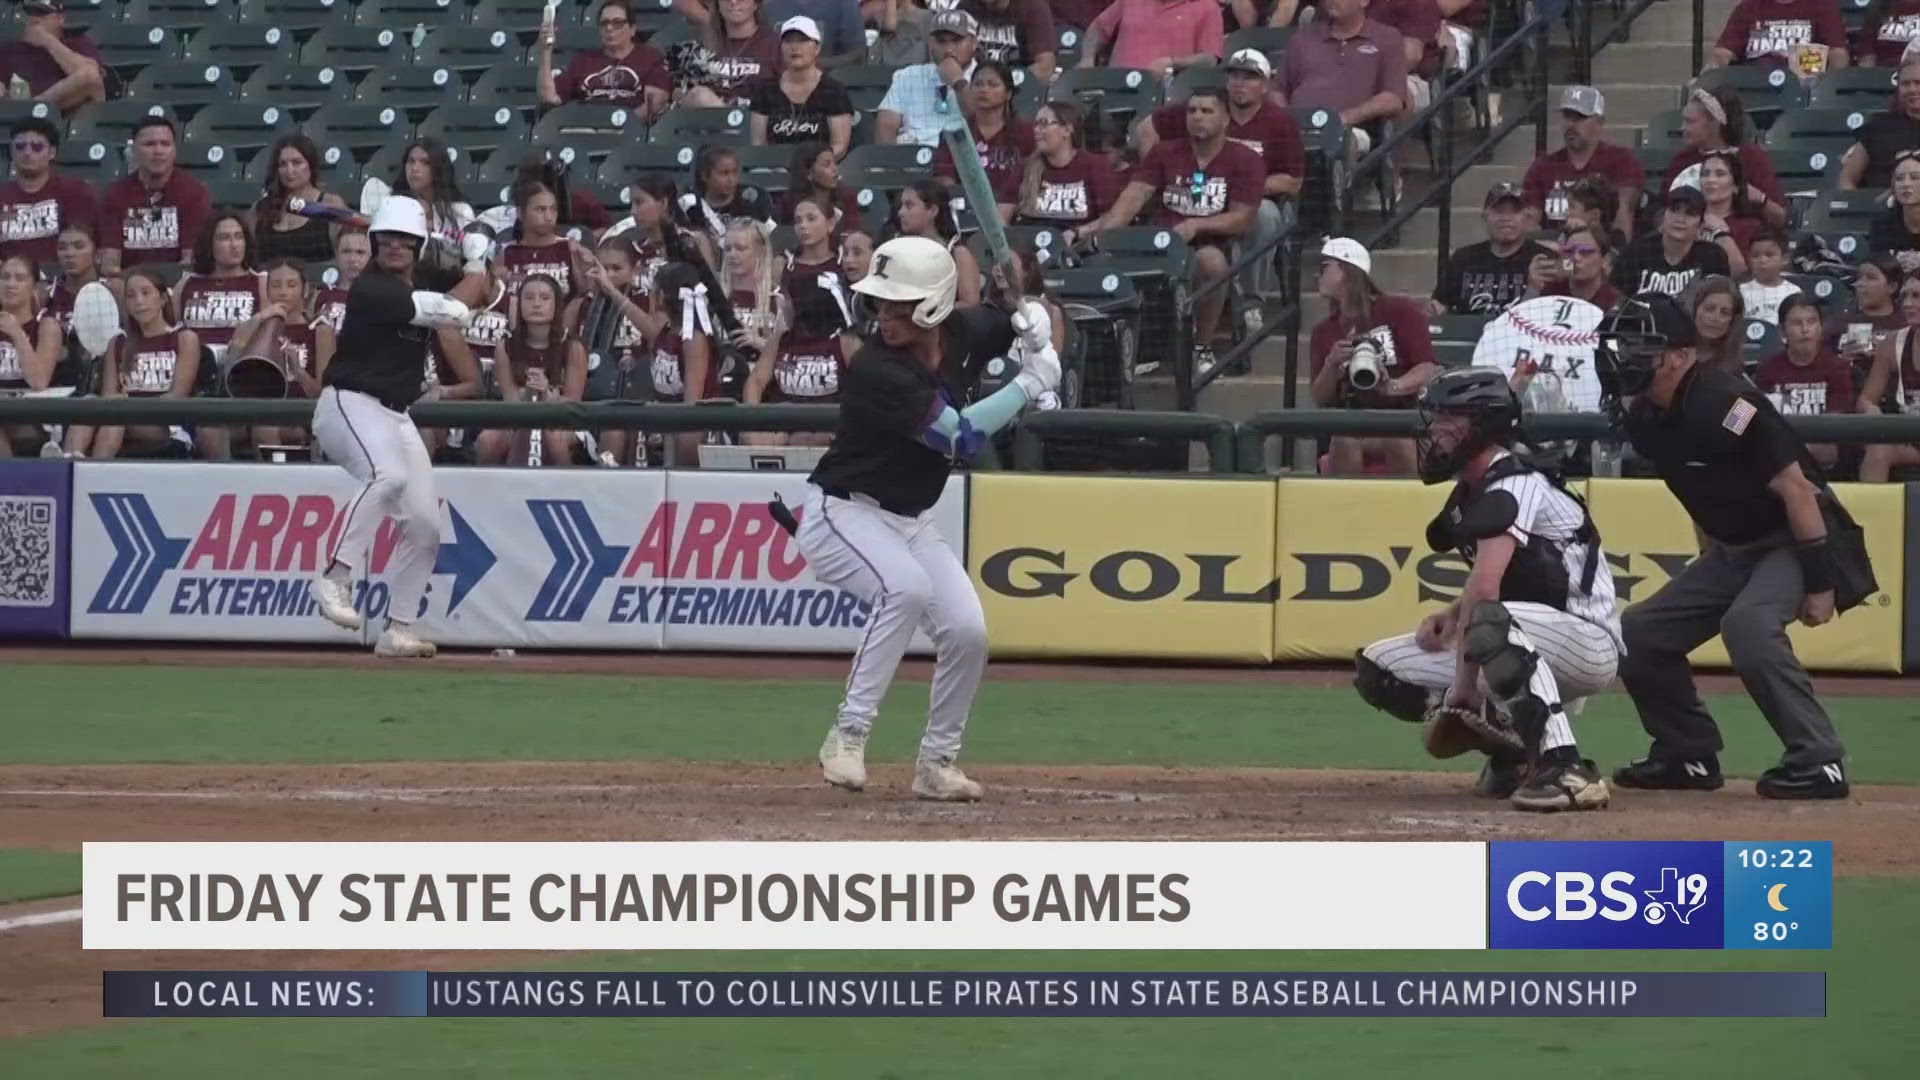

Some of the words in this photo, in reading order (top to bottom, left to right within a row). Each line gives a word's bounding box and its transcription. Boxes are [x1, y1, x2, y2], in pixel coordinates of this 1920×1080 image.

[184, 494, 443, 574] ARR
[622, 501, 808, 582] ARRO
[980, 545, 1472, 605] GOLD'S
